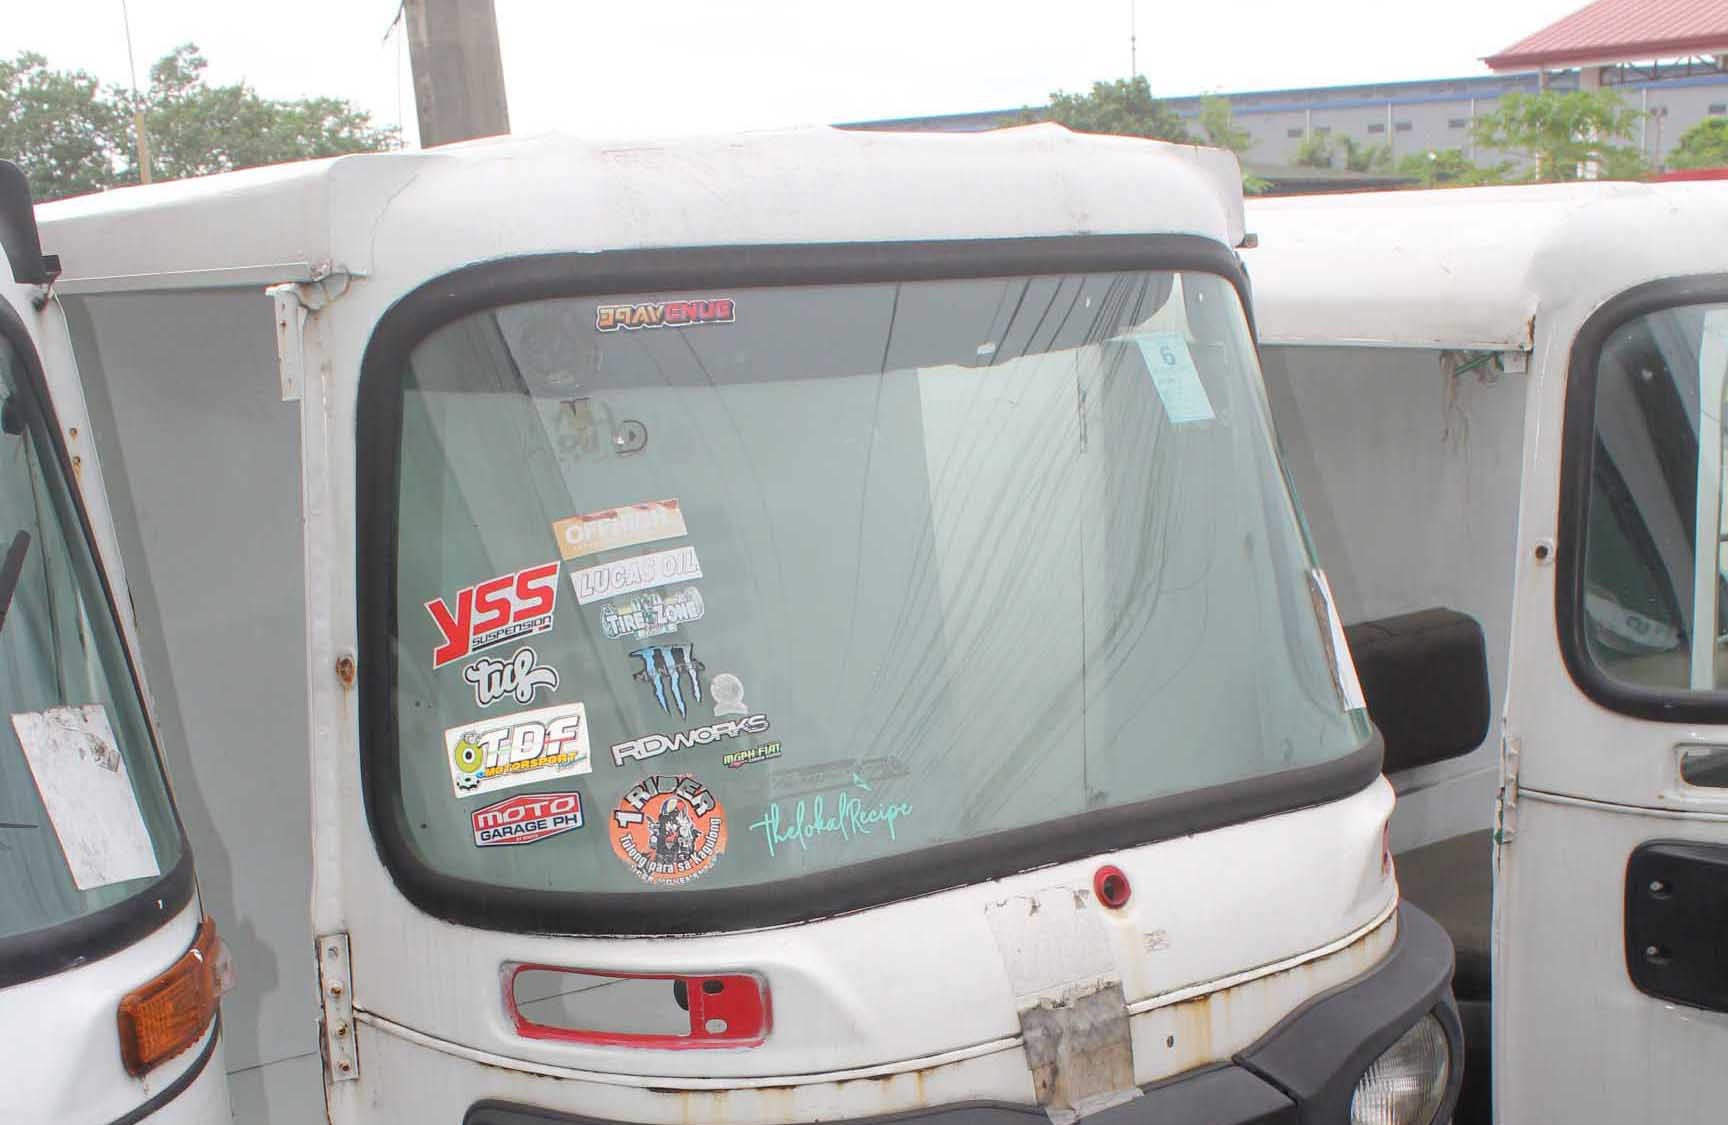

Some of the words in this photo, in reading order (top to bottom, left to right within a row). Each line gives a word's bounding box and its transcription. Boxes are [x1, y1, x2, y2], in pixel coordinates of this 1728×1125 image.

[579, 561, 656, 597] LUCAS
[426, 563, 559, 667] YSS
[472, 615, 552, 647] SUSPENSION
[606, 610, 646, 635] TIRE
[655, 599, 701, 625] ZONE
[478, 714, 581, 769] TDF
[610, 713, 770, 767] RDWORKS
[484, 752, 577, 777] MOTORSPORT
[477, 796, 577, 829] MOTO
[623, 775, 717, 818] RIDER
[480, 818, 549, 842] GARAGE
[553, 813, 578, 828] PH
[620, 833, 648, 868] Tulong
[647, 861, 674, 874] para
[677, 859, 693, 872] sa
